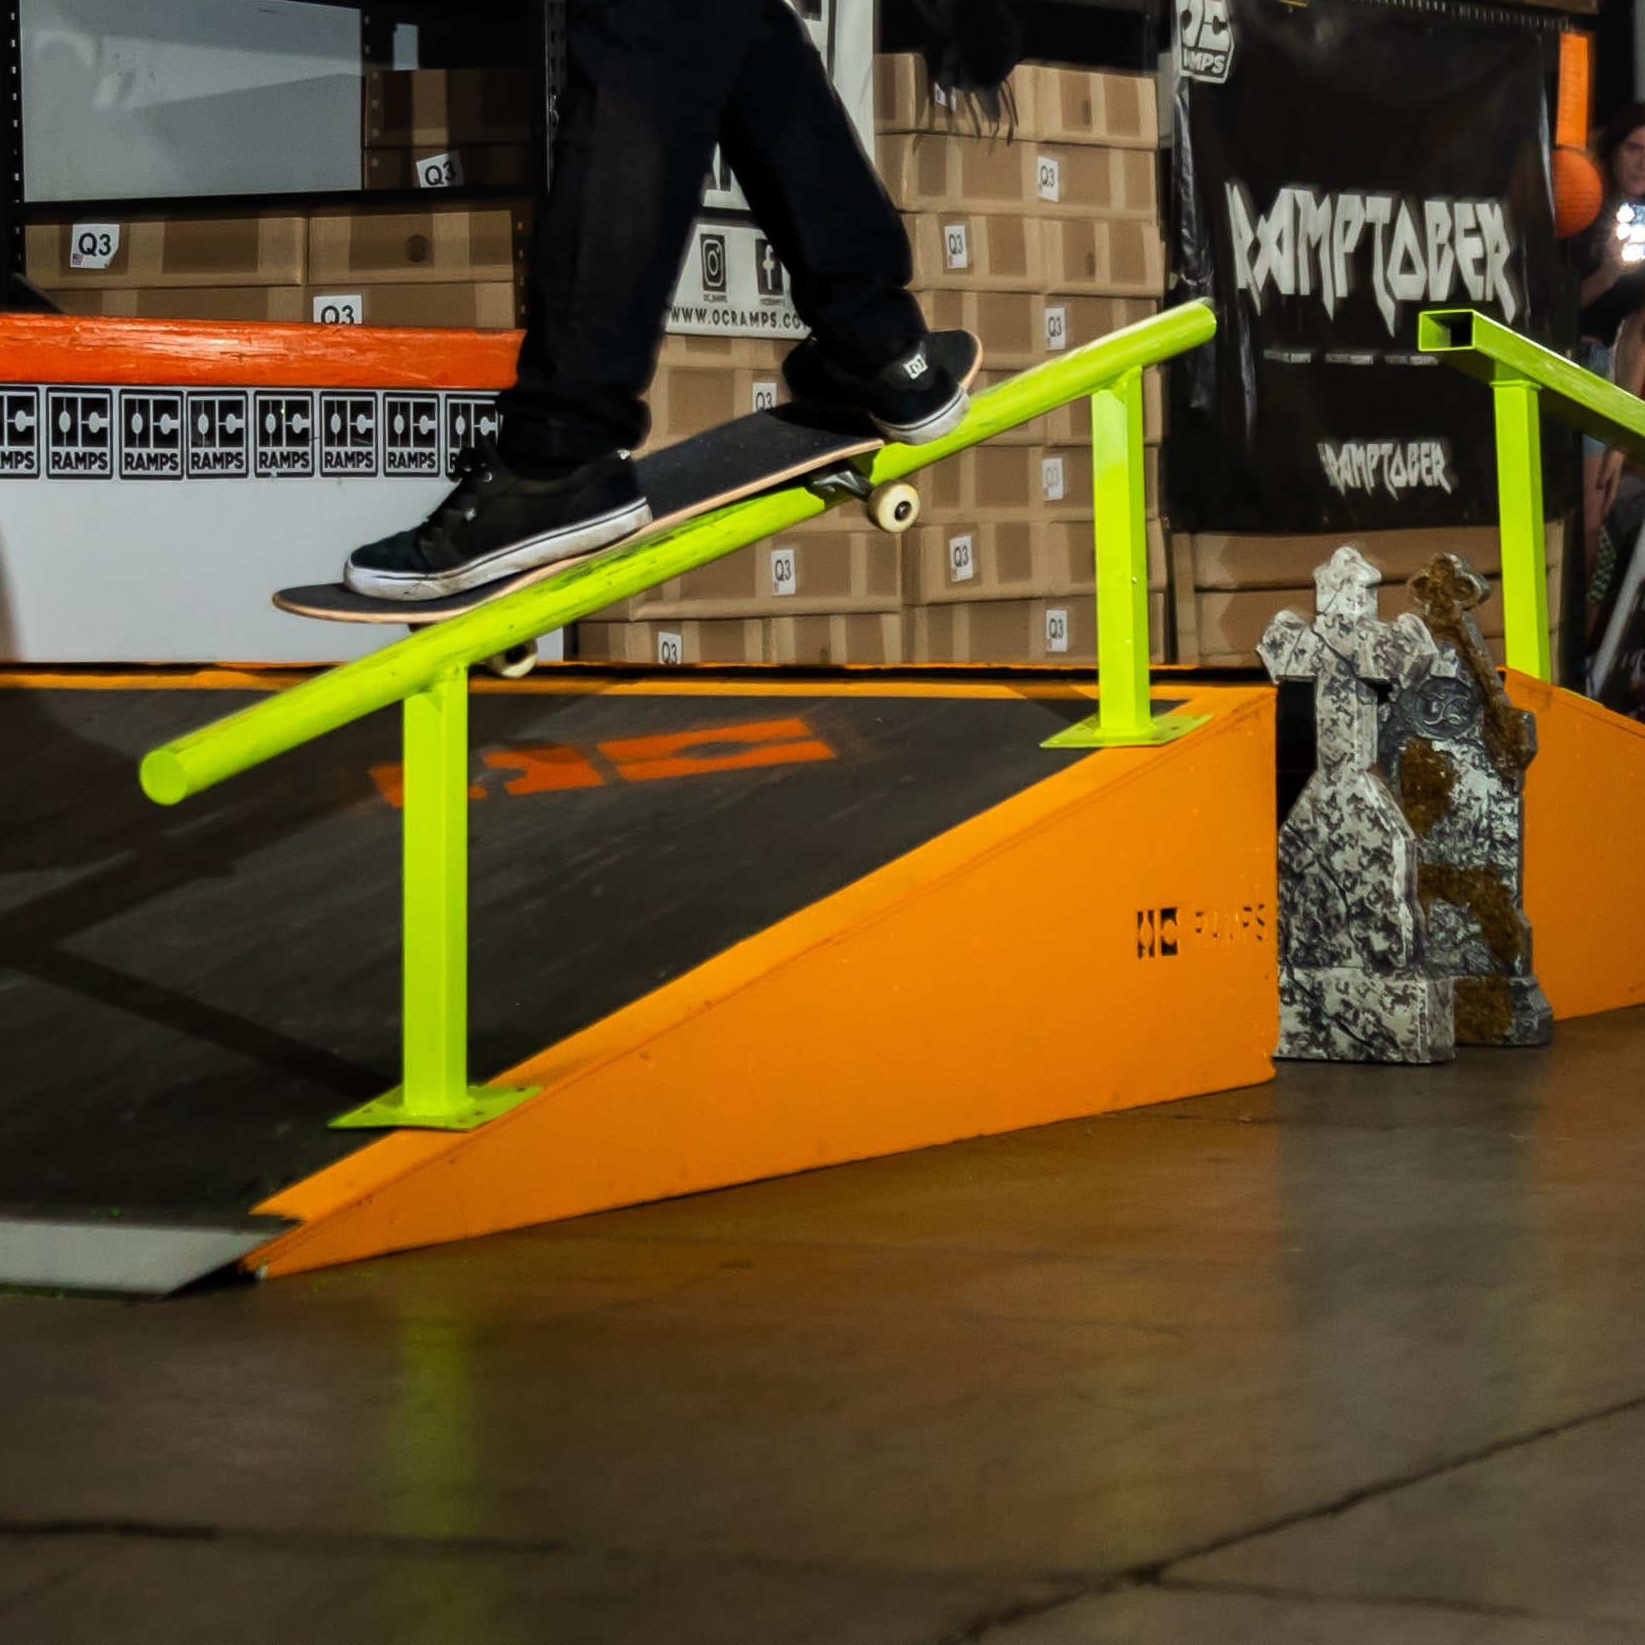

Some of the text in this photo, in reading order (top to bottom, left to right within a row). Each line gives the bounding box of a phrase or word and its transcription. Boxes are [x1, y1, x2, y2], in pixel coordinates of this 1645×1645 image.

[424, 161, 457, 187] Q3
[1040, 164, 1055, 188] Q3
[78, 232, 112, 257] Q3
[948, 233, 964, 255] Q3
[1225, 182, 1517, 337] RAMPTOBER
[671, 307, 803, 330] WWW.OCRAMPS.CO
[1048, 316, 1063, 338] Q3
[755, 391, 774, 411] Q3
[52, 451, 108, 471] RAMPS
[124, 452, 179, 471] RAMPS
[191, 452, 244, 470] RAMPS
[258, 451, 310, 469] RAMPS
[324, 451, 374, 469] RAMPS
[388, 452, 436, 470] RAMPS
[953, 545, 969, 568] Q3
[774, 559, 792, 582] Q3
[1048, 618, 1064, 640] Q3
[661, 641, 678, 664] Q3
